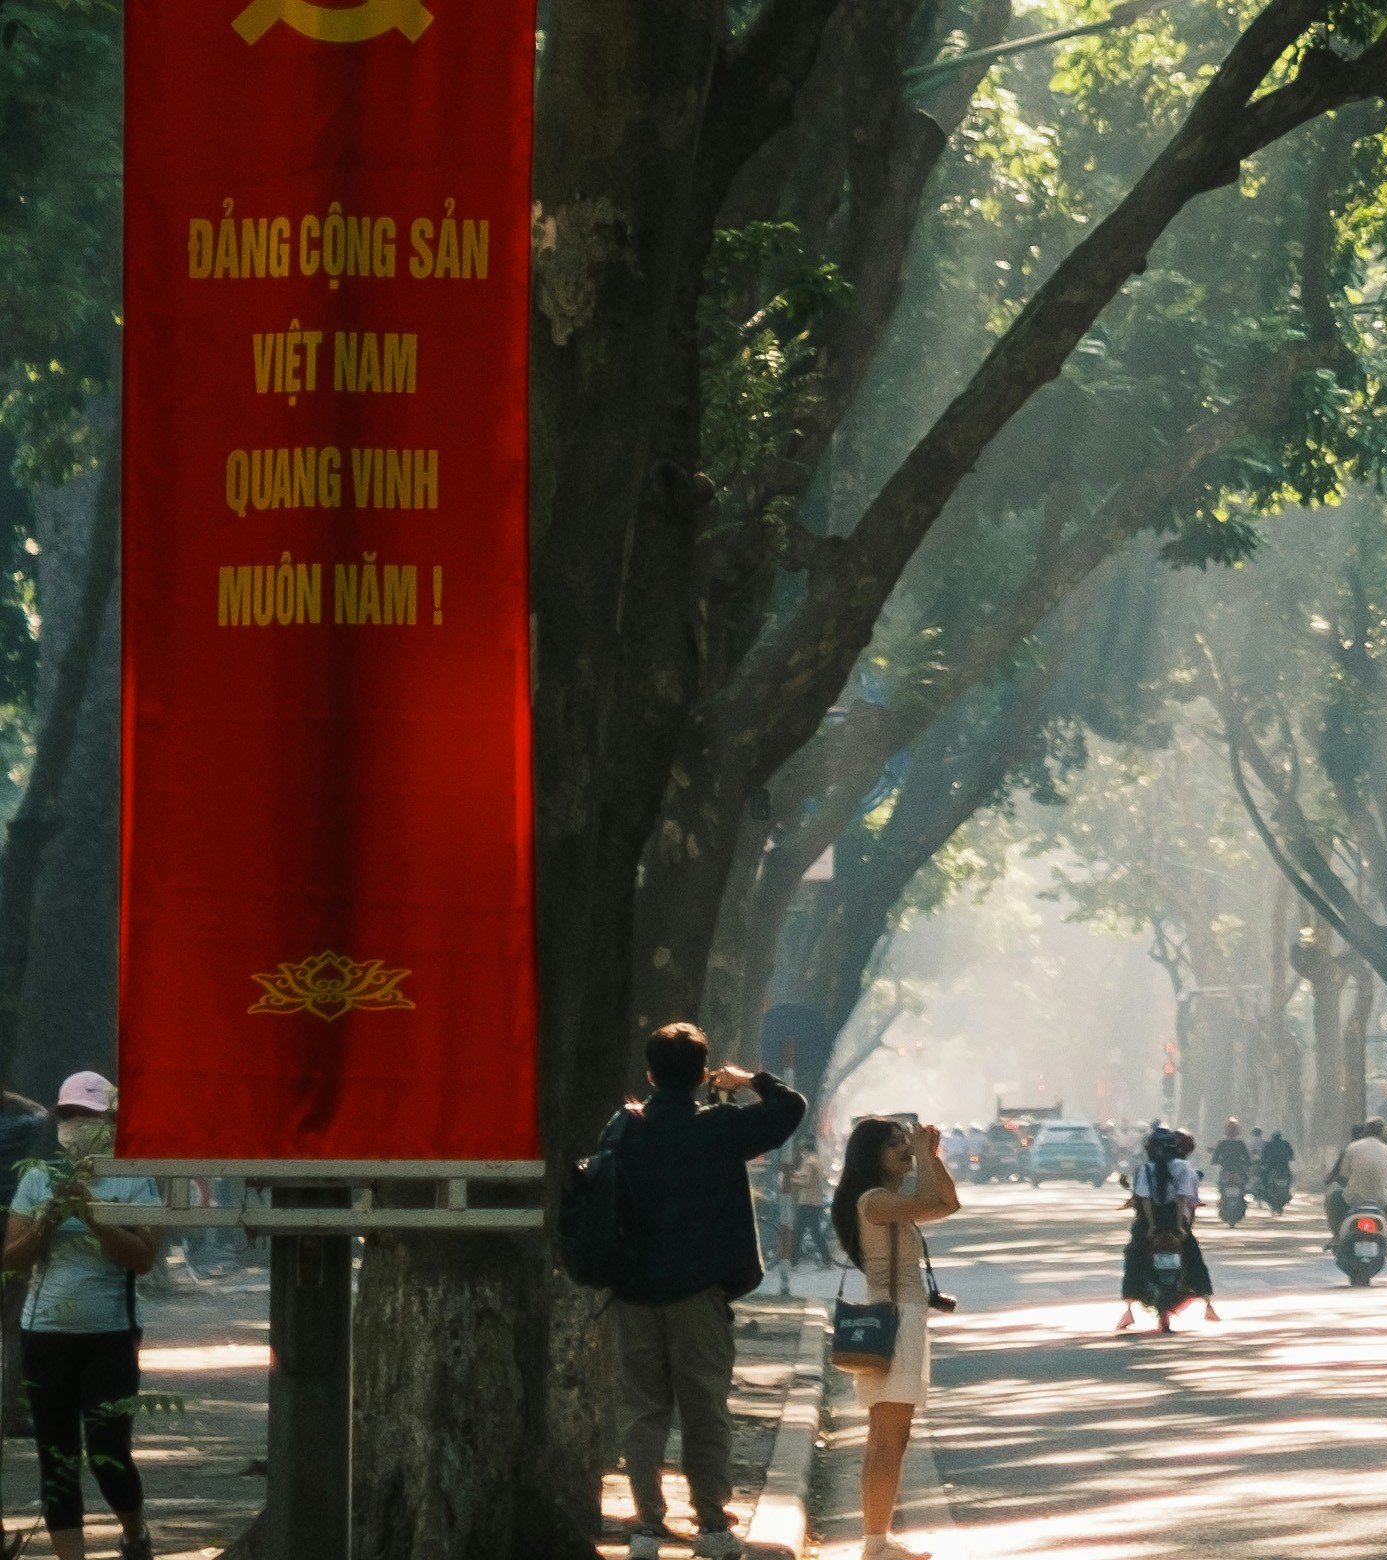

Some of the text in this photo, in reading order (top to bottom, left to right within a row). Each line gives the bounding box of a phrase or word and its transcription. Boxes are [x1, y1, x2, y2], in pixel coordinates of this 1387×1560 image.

[187, 196, 490, 290] ĐẢNG CỘNG SẢN
[252, 317, 418, 406] VIỆT NAM
[224, 445, 439, 518] QUANG VINH
[217, 550, 323, 626] MUÔN
[334, 550, 418, 626] NĂM
